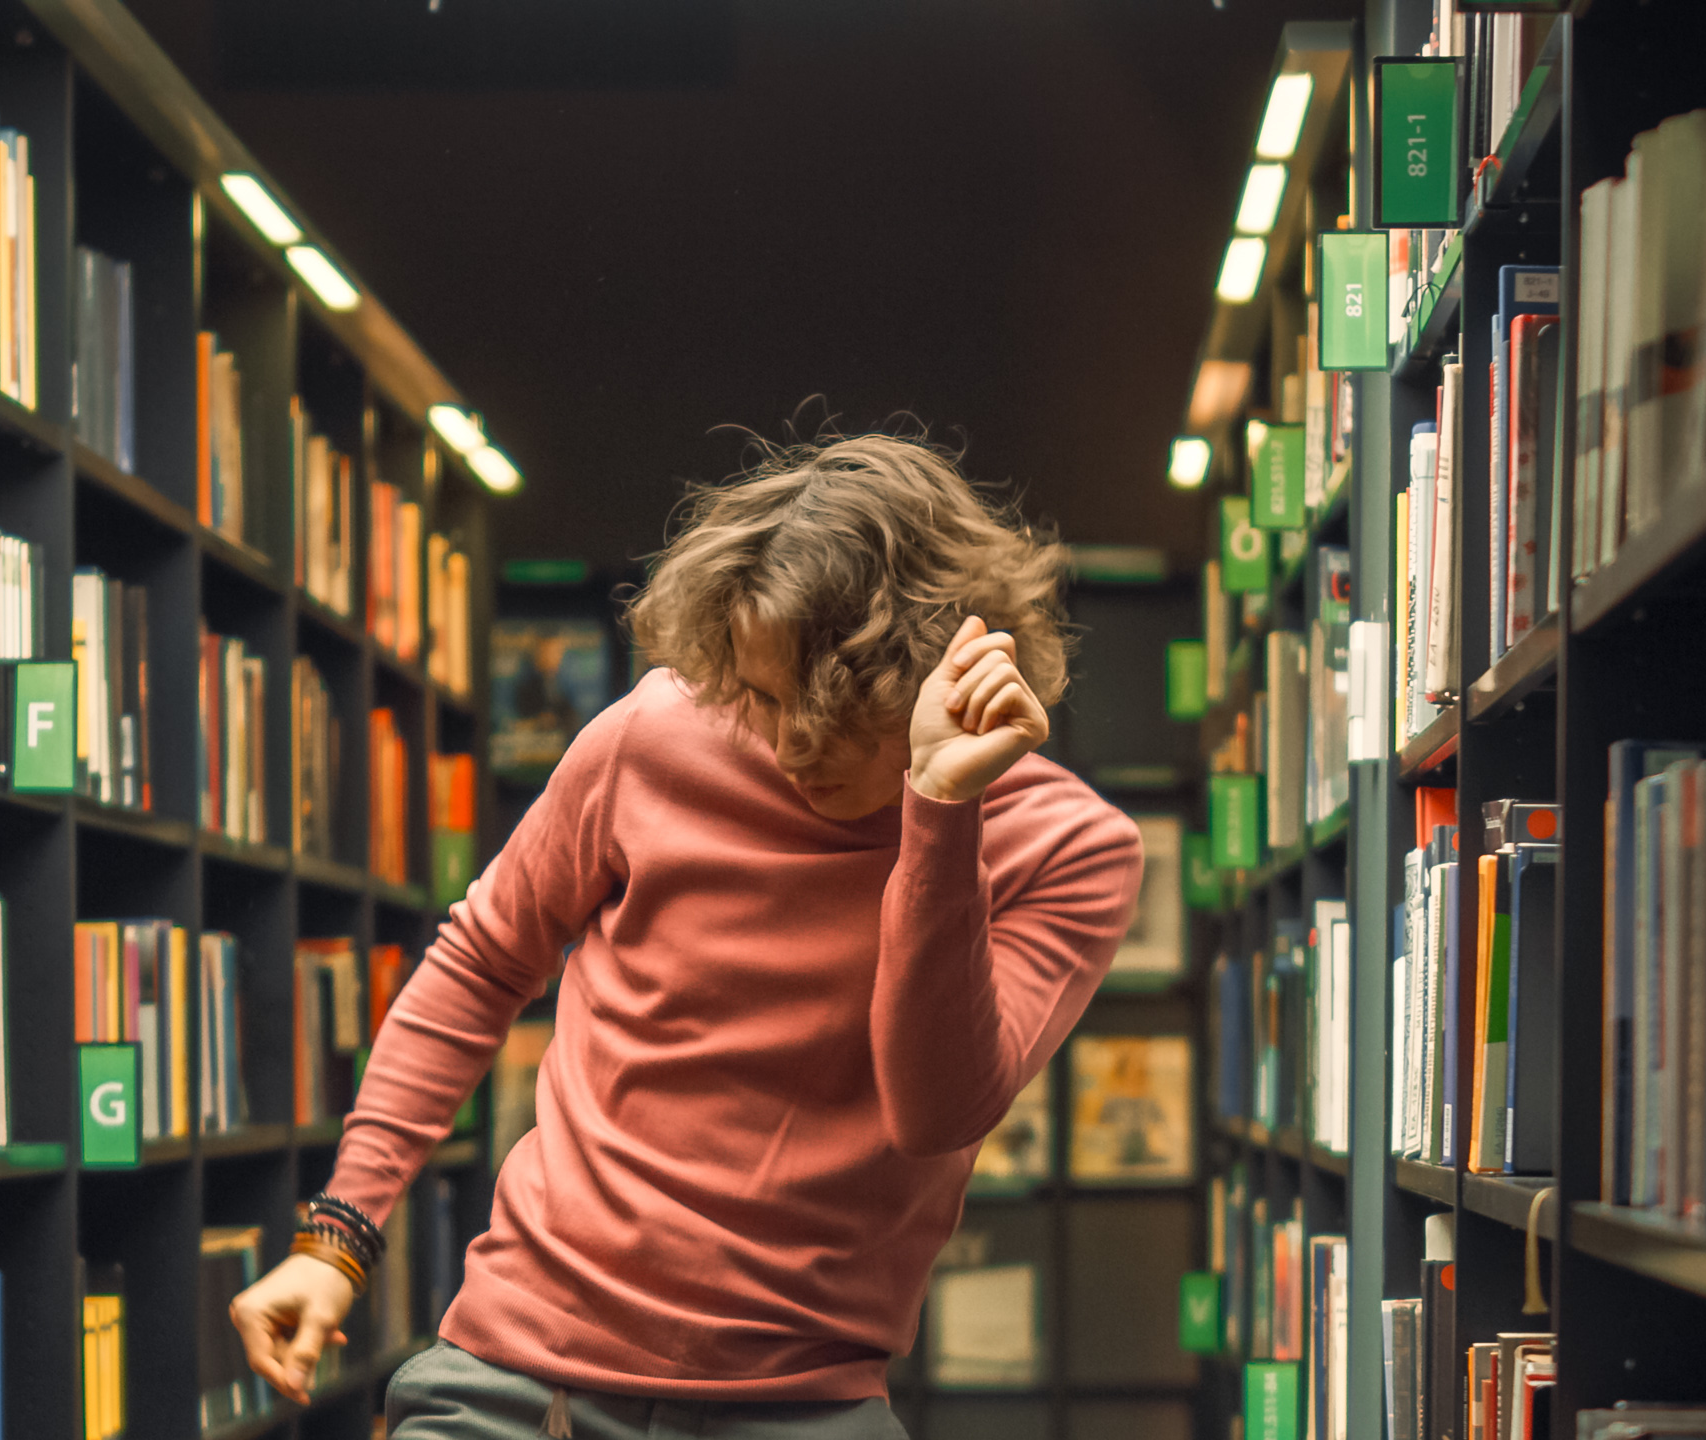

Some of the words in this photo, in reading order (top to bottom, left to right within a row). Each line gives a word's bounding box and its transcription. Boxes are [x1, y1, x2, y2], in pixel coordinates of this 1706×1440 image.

[1408, 114, 1427, 177] 821-1
[1345, 283, 1363, 317] 821
[27, 701, 56, 748] F
[89, 1081, 126, 1127] G
